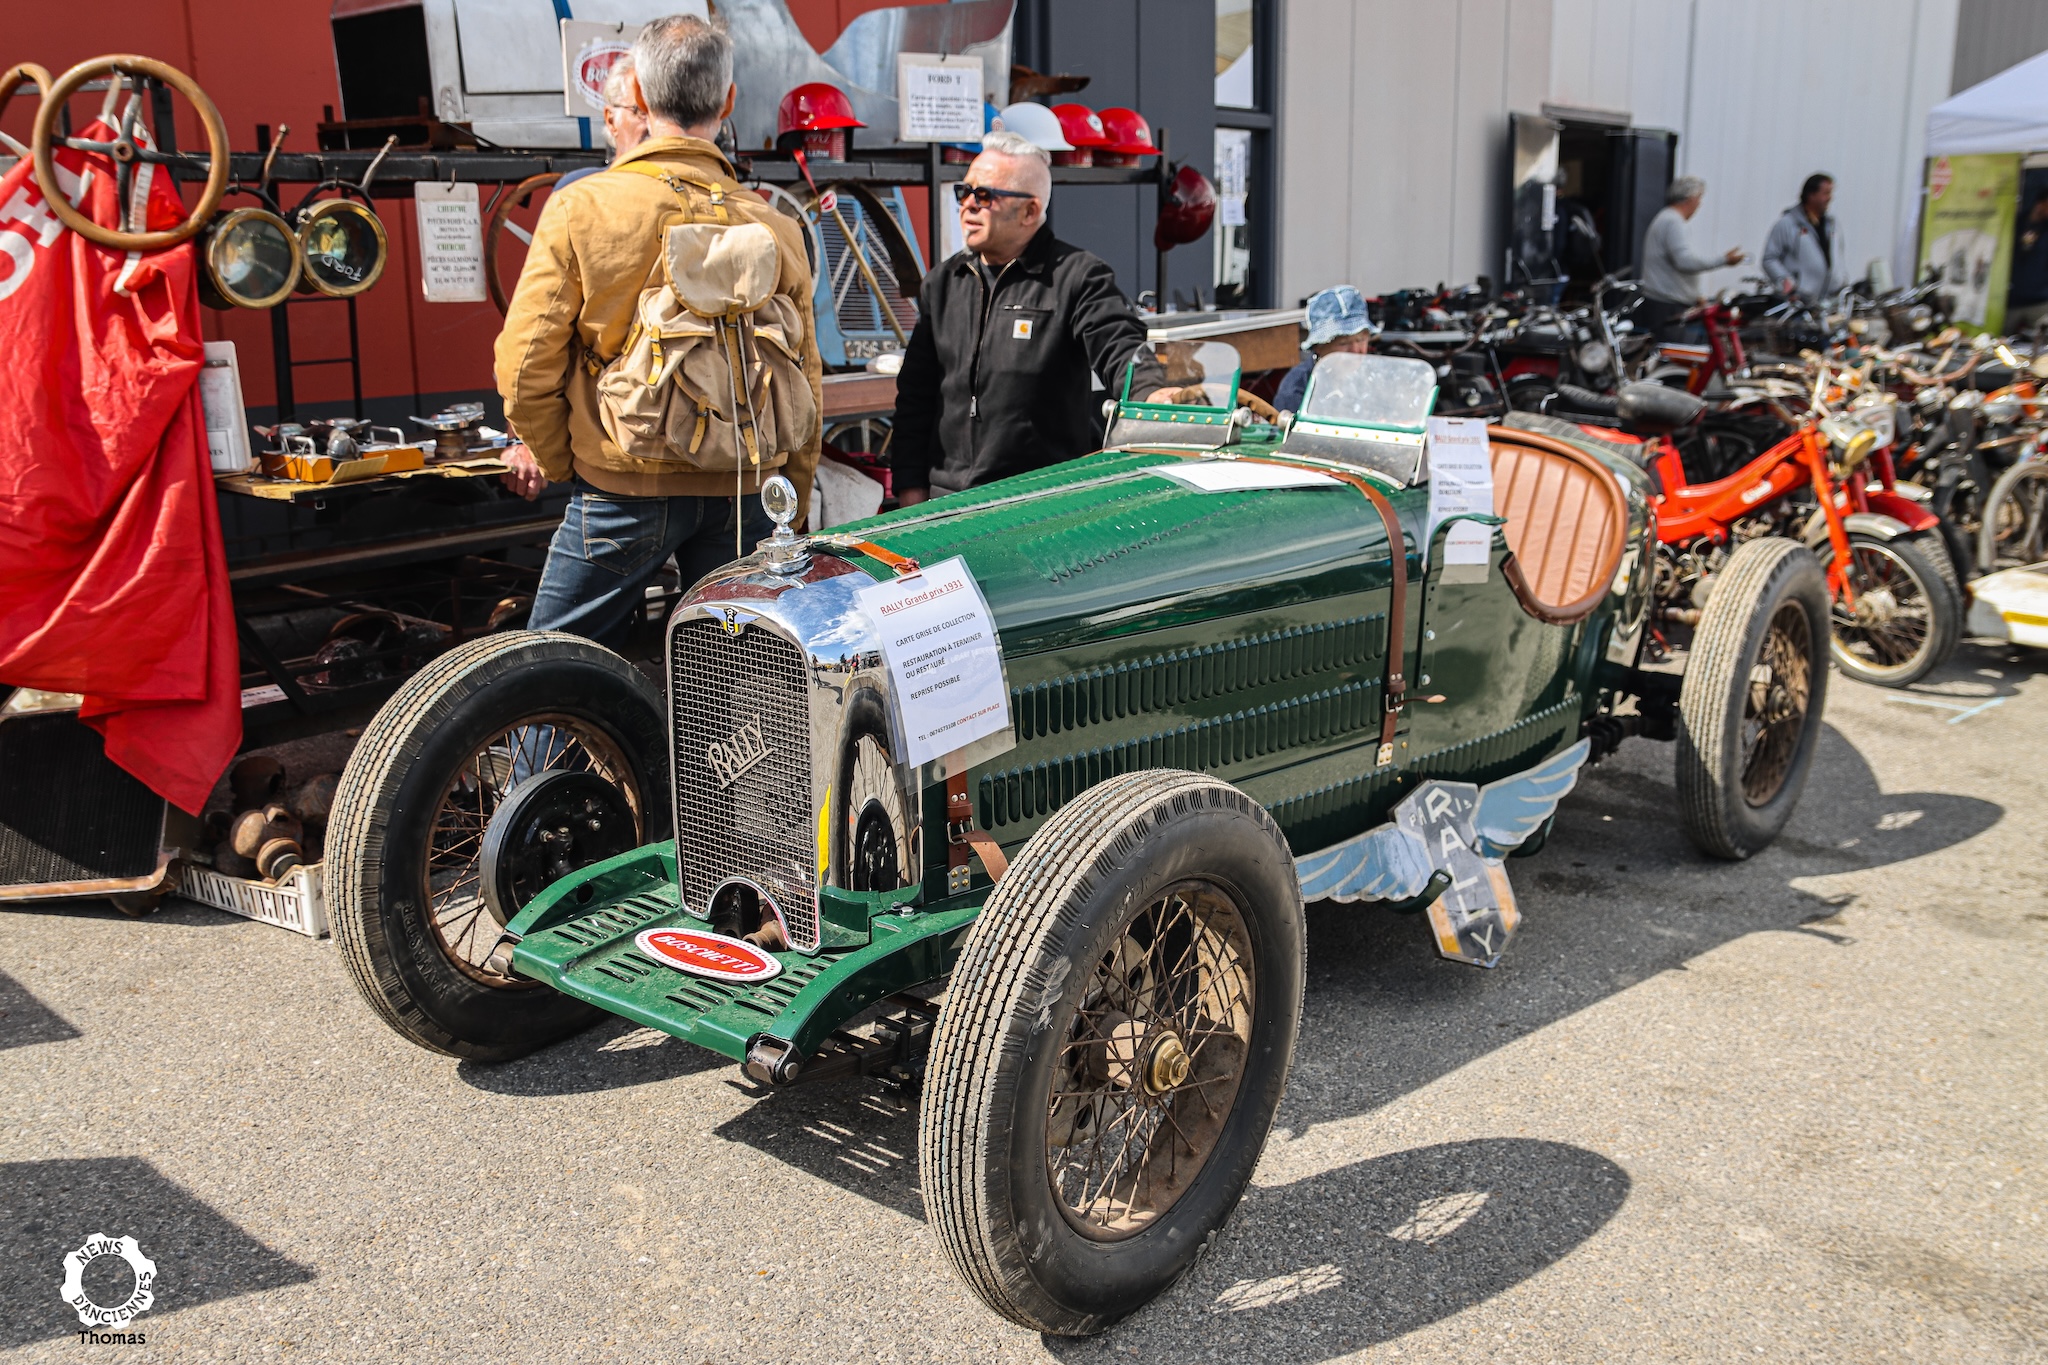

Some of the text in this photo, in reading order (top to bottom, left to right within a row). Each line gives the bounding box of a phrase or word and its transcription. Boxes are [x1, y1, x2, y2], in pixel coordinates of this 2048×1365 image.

[321, 255, 363, 282] FORD
[880, 579, 963, 615] RALLY Grand prix 1931
[895, 612, 976, 647] CARTE GRISE DE COLLECTION
[902, 632, 982, 668] RESTAURATION À TERMINER
[905, 657, 946, 679] OU RESTAURÉ
[910, 675, 961, 700] REPRISE POSSIBLE
[956, 712, 977, 726] CONTACT
[977, 709, 987, 717] SUR
[987, 703, 1000, 713] PLACE
[708, 713, 774, 790] RALLY
[1425, 787, 1495, 956] RALLY
[653, 935, 761, 972] BOSCHETTI
